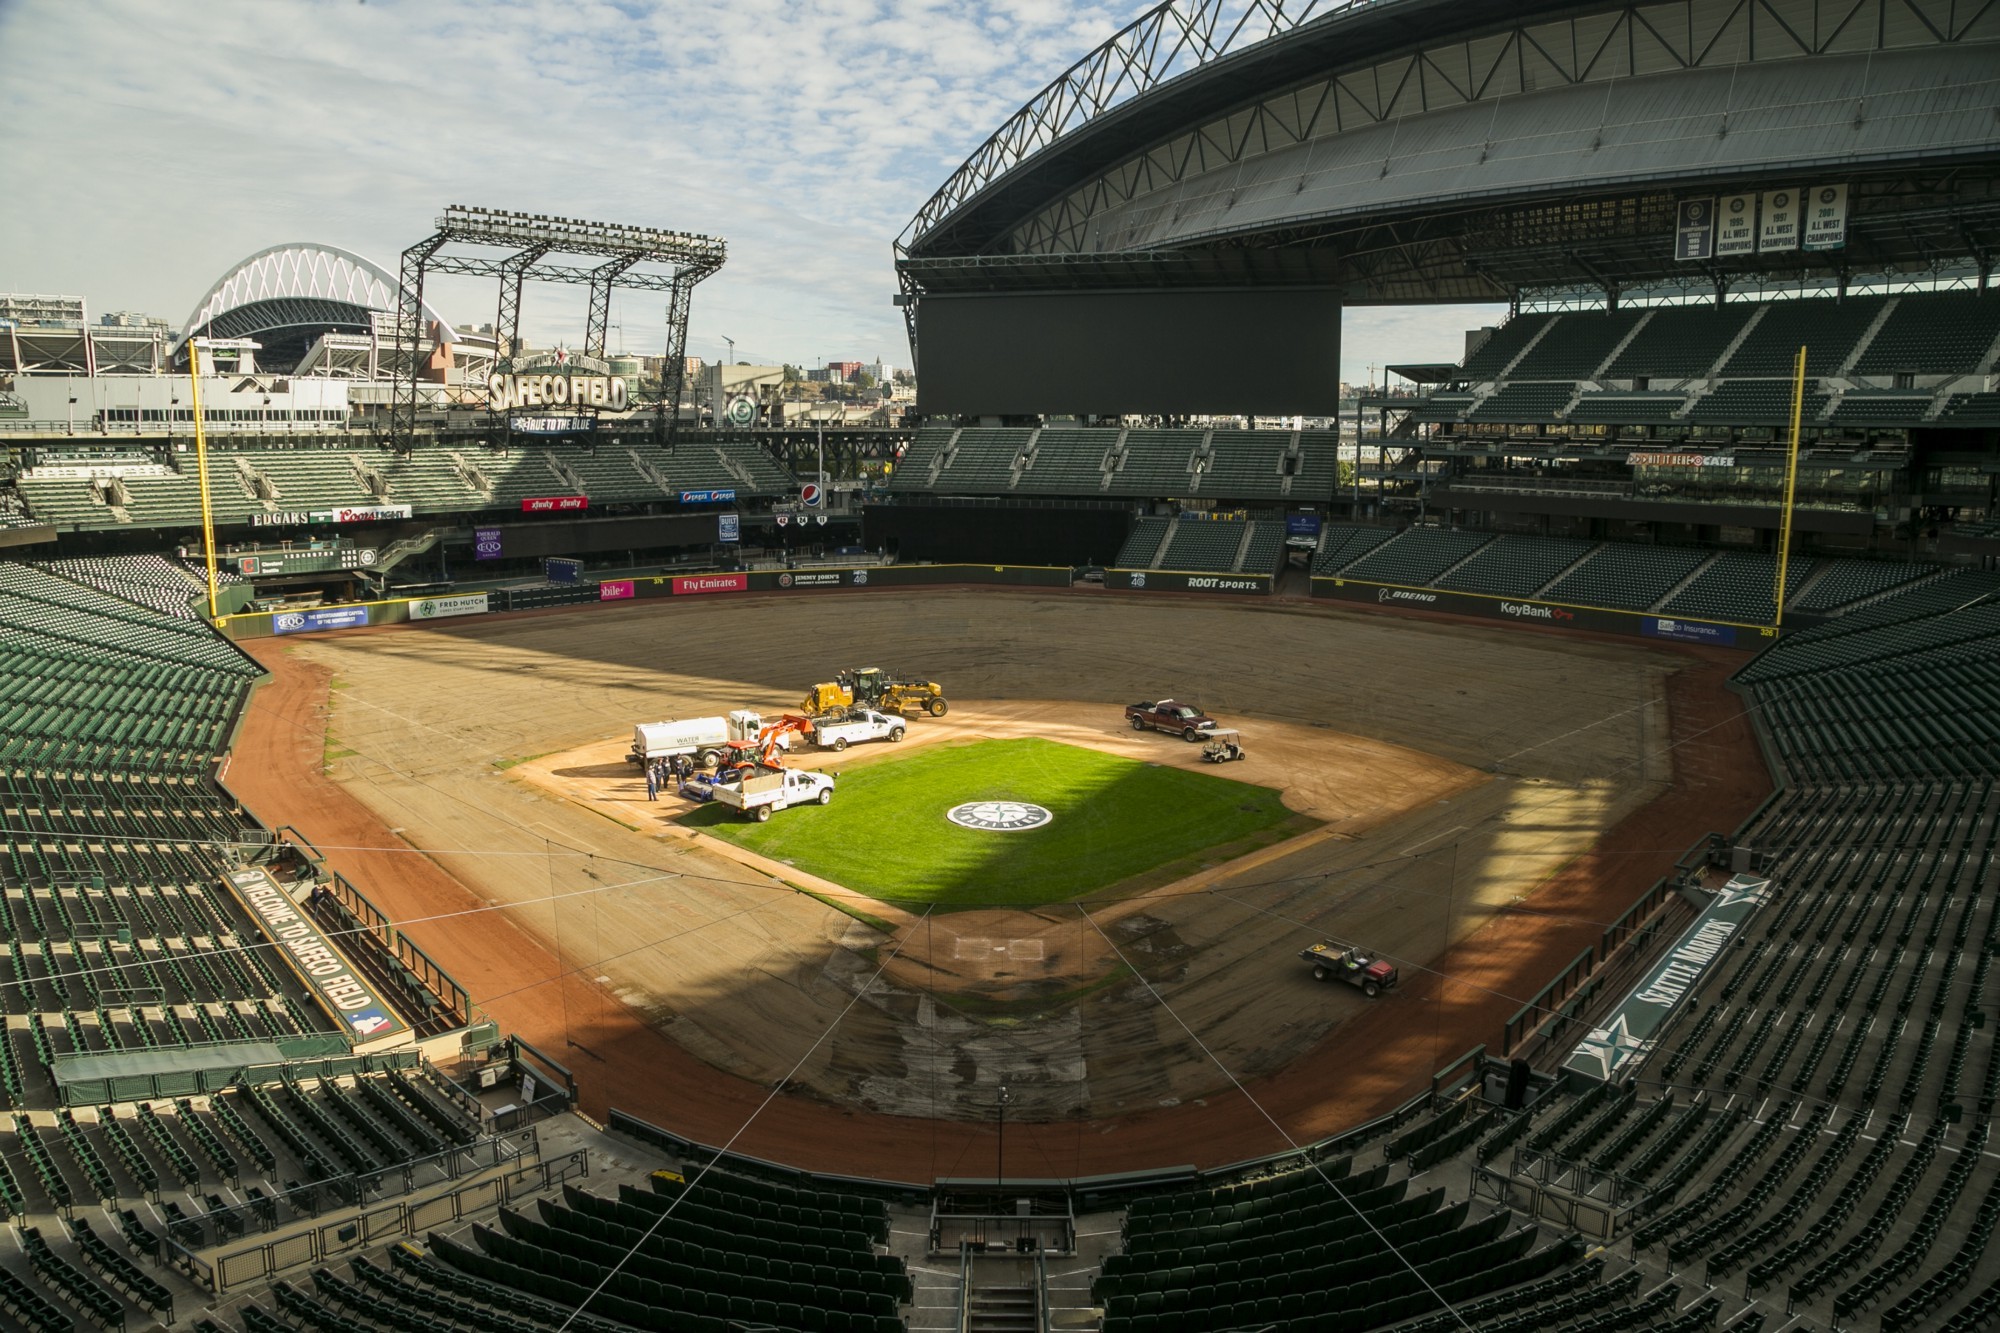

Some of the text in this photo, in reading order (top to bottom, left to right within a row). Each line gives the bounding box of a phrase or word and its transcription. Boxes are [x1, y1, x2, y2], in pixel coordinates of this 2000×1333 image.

[1773, 213, 1787, 223] 1997
[1818, 207, 1835, 218] 2001
[1729, 218, 1744, 227] 1995
[1823, 219, 1841, 229] WEST
[1680, 225, 1710, 233] CHAMPIONSHIP
[1733, 228, 1750, 238] WEST
[1776, 224, 1793, 233] WEST
[1761, 237, 1796, 248] CHAMPIONS
[1806, 232, 1843, 243] CHAMPIONS
[1719, 241, 1752, 251] CHAMPIONS
[572, 352, 610, 375] MARINERS
[489, 373, 628, 412] SAFECO FIELD
[526, 417, 591, 430] TRUE TO THE BLUE
[1648, 455, 1735, 467] HIT IT HERE CAFE
[340, 508, 375, 522] Coors
[374, 510, 405, 520] LIGHT
[479, 542, 501, 552] EQC
[683, 579, 737, 590] Fly Emirates
[1188, 577, 1257, 590] ROOT SPORTS
[1392, 590, 1436, 602] BOEING
[460, 598, 484, 606] HUTCH
[1501, 602, 1552, 618] KeyBank
[278, 617, 305, 627] EQC
[1659, 620, 1717, 635] Safeco Insurance
[1760, 628, 1774, 637] 326
[242, 880, 373, 1010] WELCOME TO SAFECO FIELD
[1635, 918, 1738, 1008] SEATTLE MARINERS
